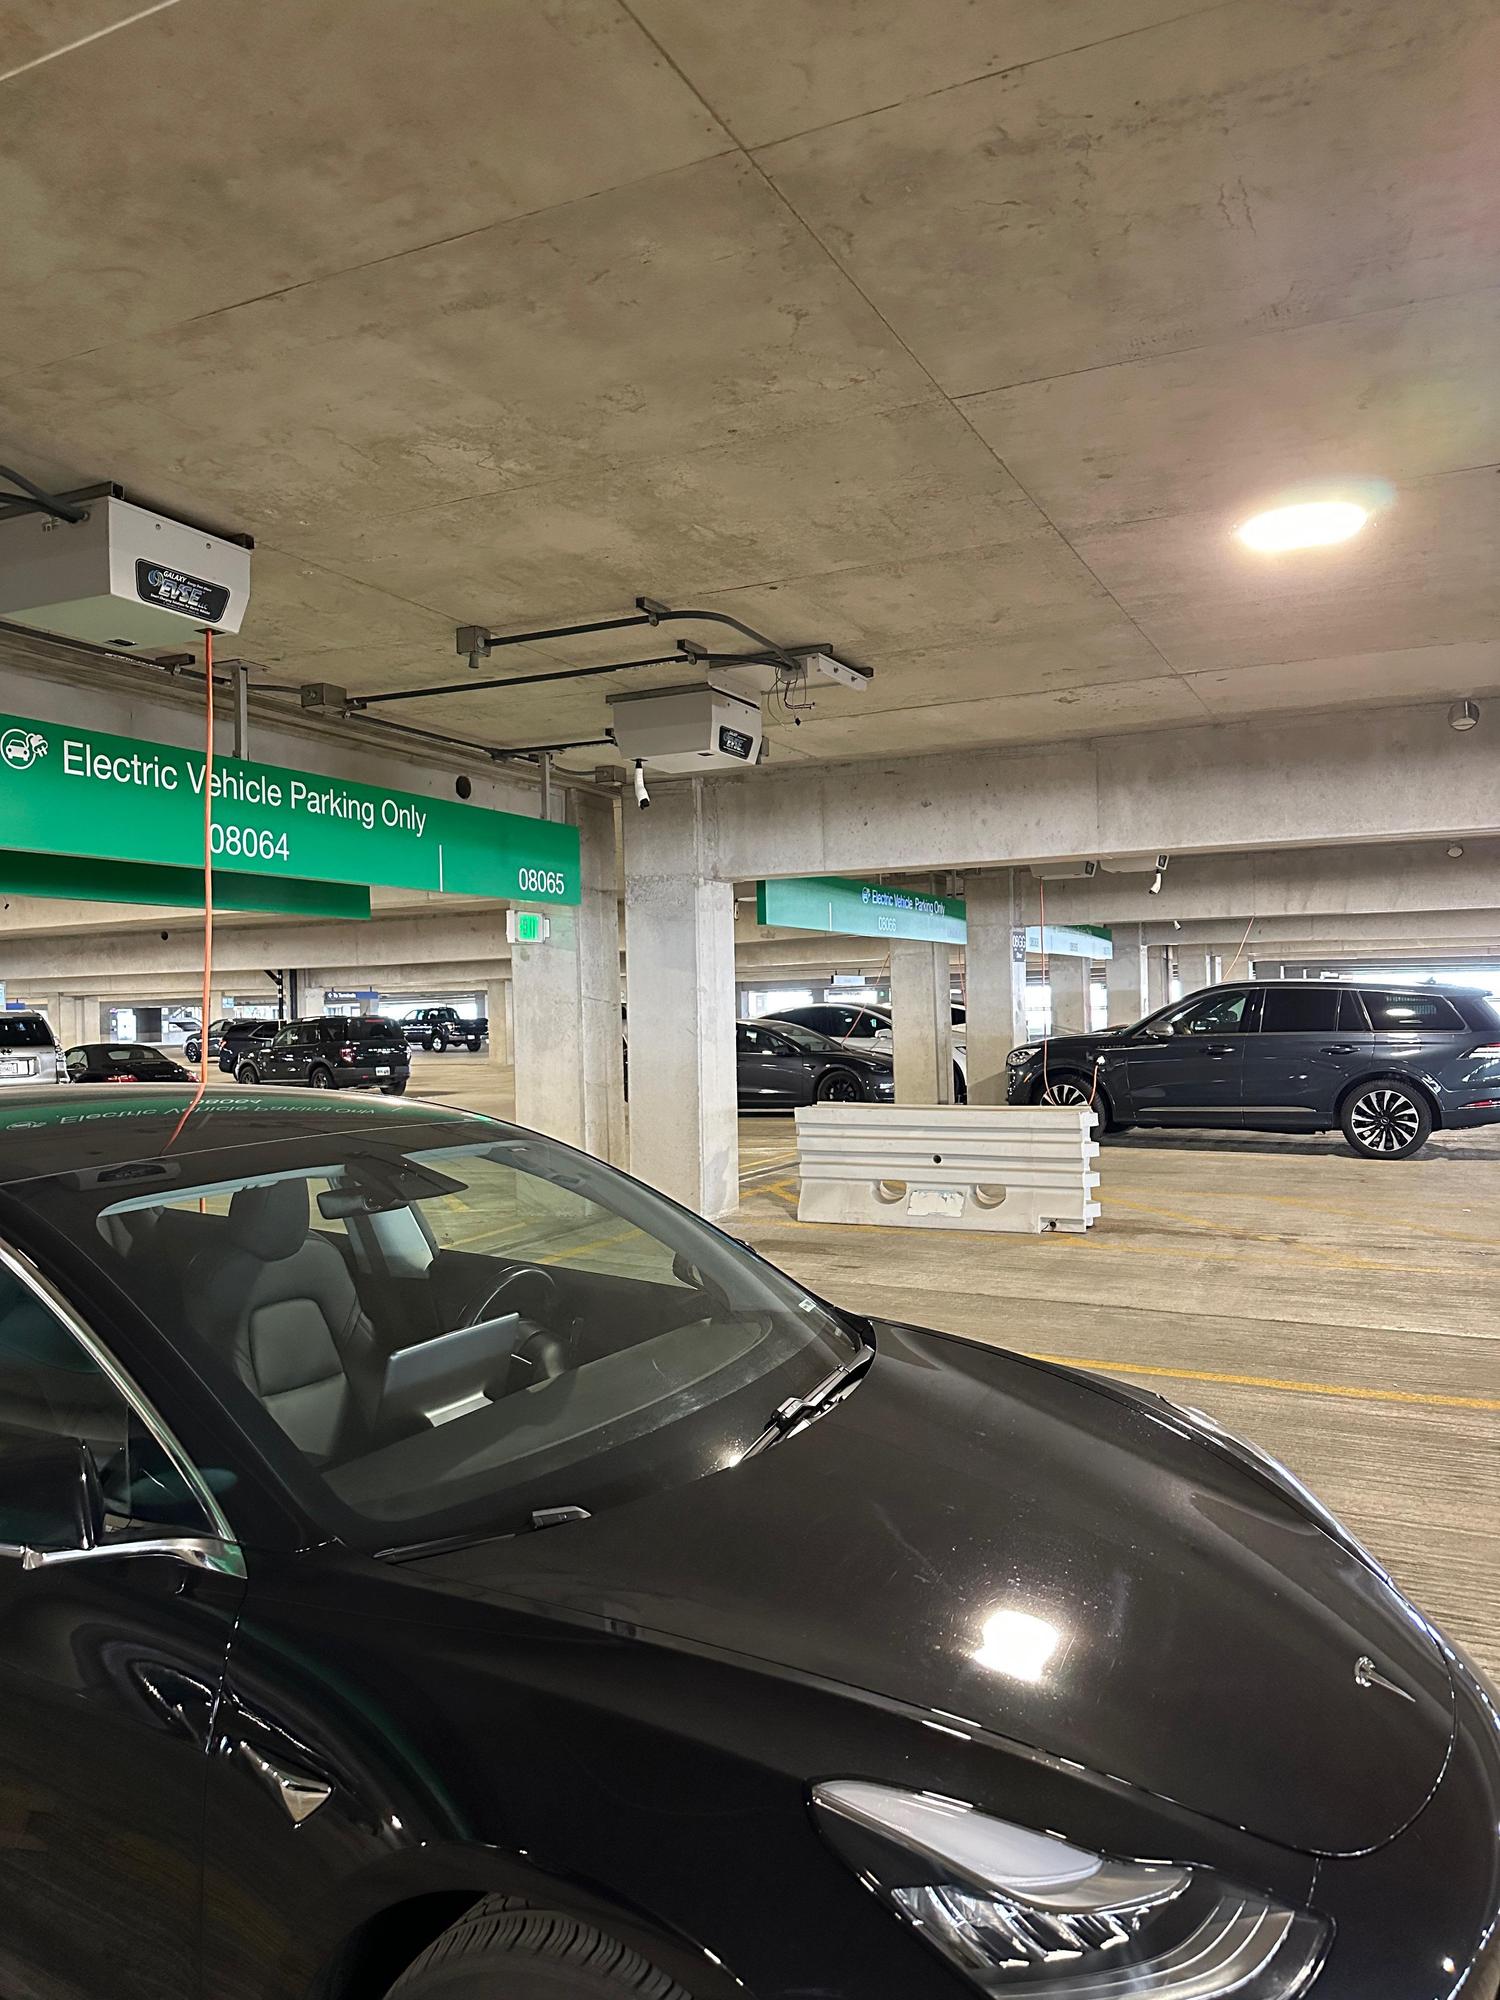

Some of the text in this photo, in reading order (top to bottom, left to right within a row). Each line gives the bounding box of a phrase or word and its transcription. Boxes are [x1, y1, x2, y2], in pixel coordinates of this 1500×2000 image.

[163, 570, 188, 583] GALAXY
[158, 578, 203, 606] EVSE
[63, 740, 427, 838] Electric Vehicle Parking Only
[209, 823, 290, 862] 08064
[518, 867, 565, 895] 08065
[872, 889, 946, 918] Electric Vehicle Parking Only
